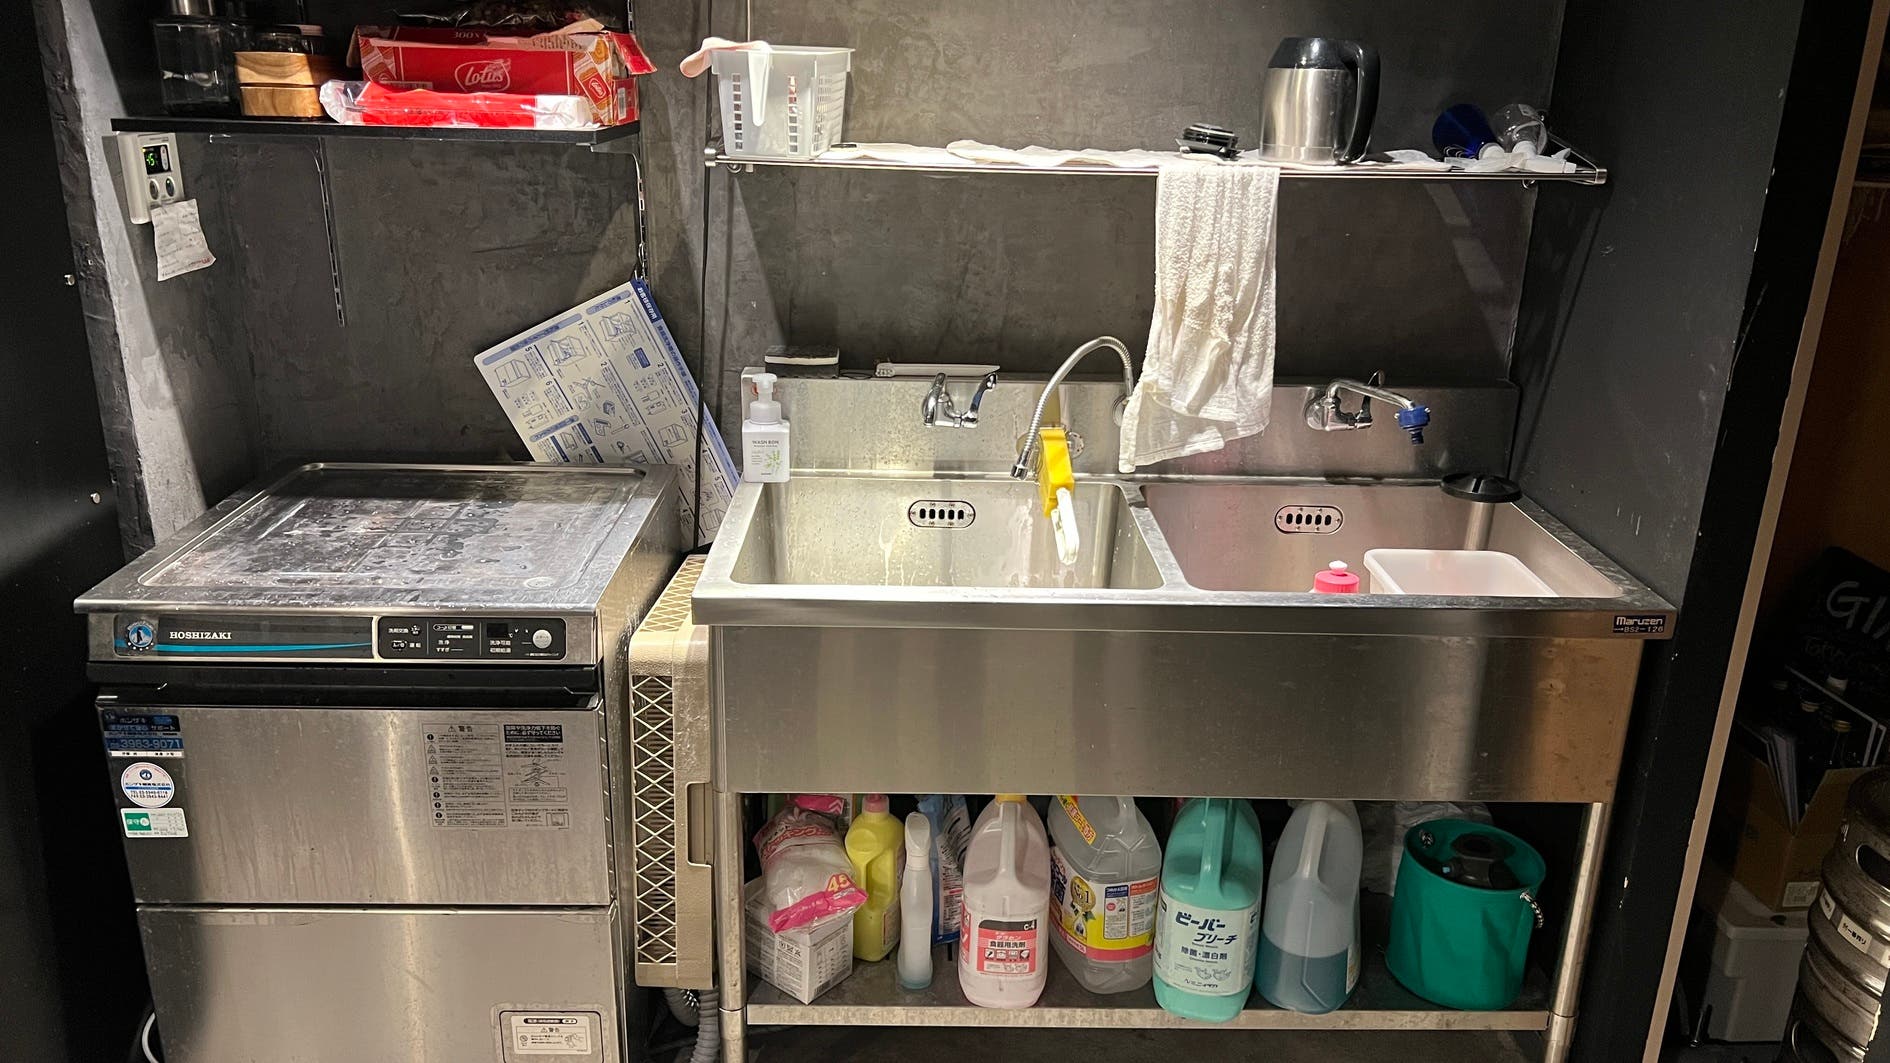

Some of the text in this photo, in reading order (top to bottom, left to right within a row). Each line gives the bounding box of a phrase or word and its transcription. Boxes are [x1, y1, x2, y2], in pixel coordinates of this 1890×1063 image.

[464, 65, 505, 86] Lotus
[1616, 616, 1663, 626] Maruzen
[169, 631, 232, 640] HOSHIZAKI
[827, 874, 850, 893] 45
[1175, 911, 1226, 932] ビーバー
[1194, 932, 1238, 945] ブリーチ
